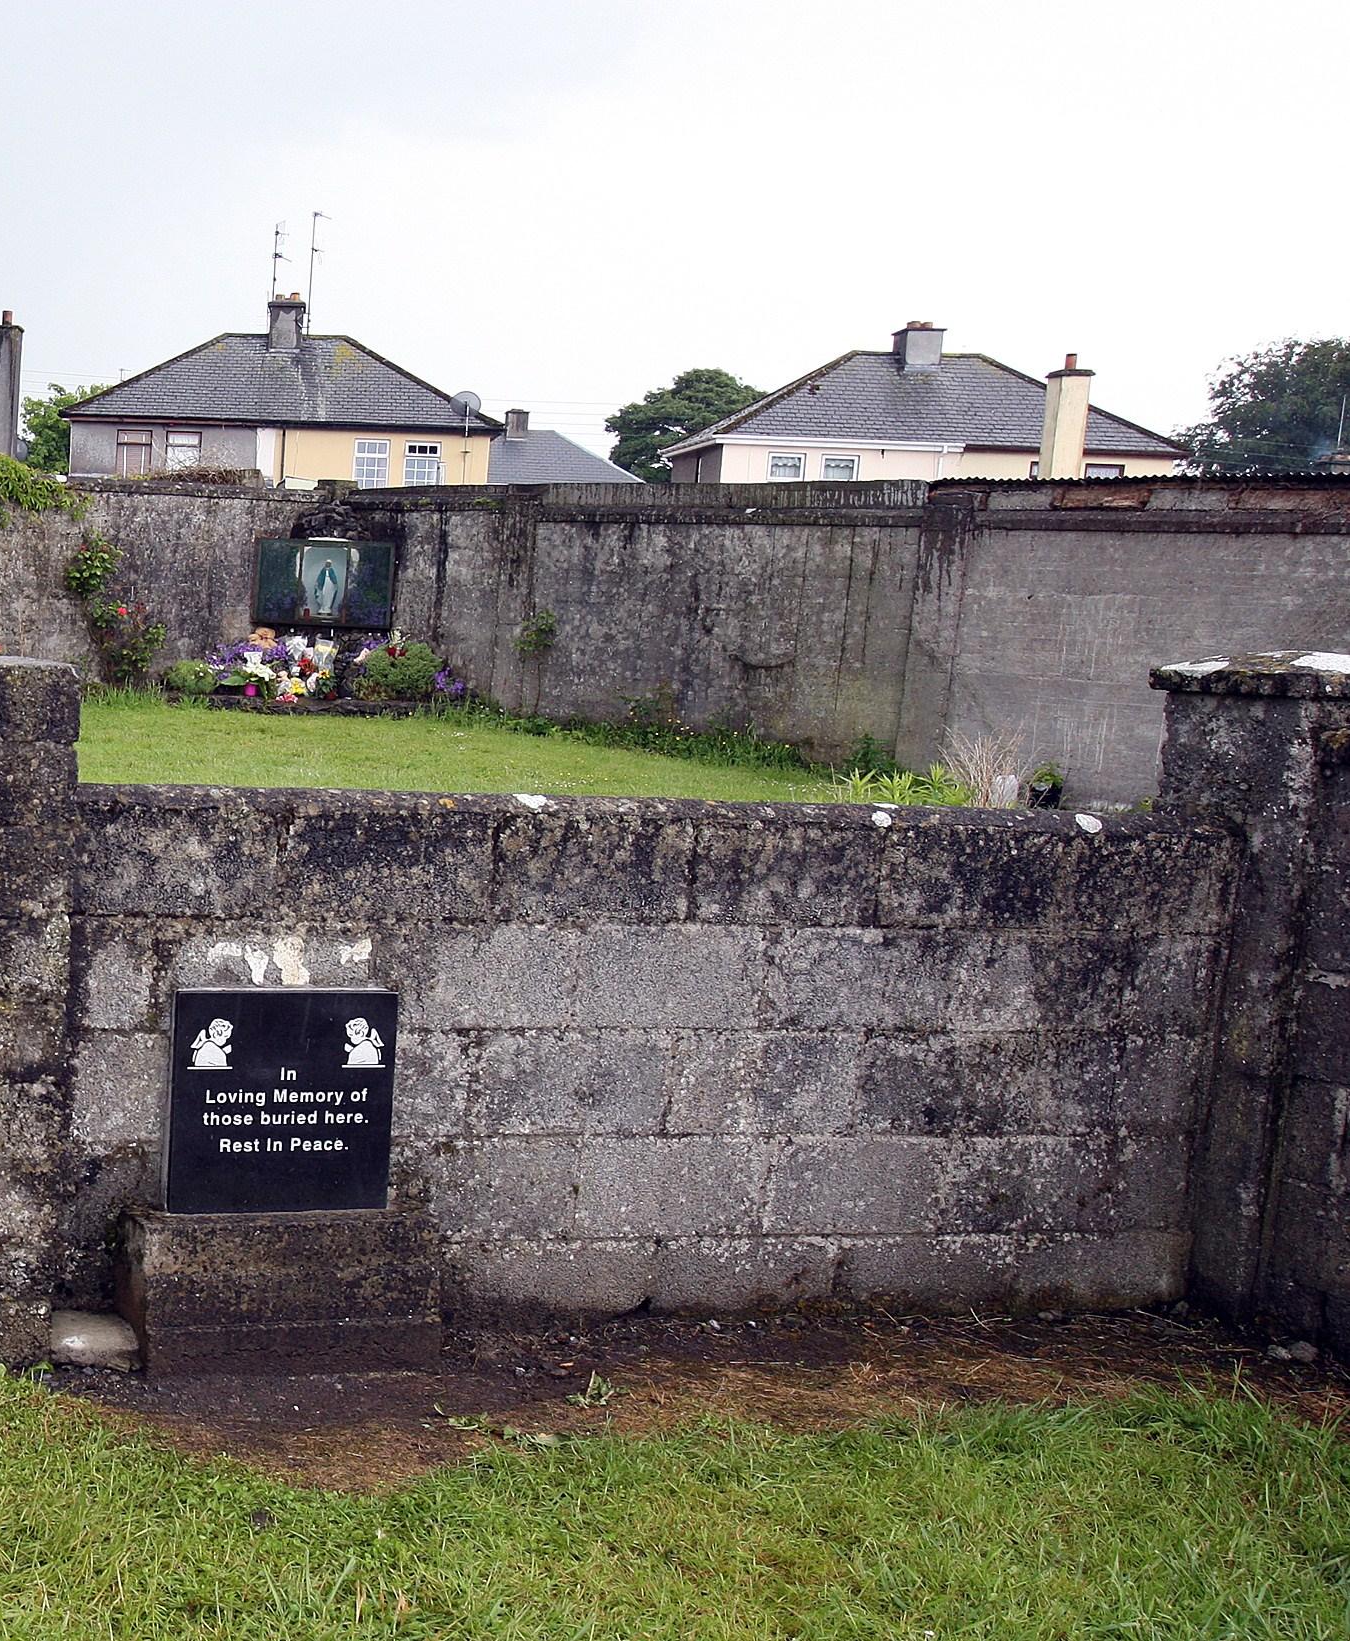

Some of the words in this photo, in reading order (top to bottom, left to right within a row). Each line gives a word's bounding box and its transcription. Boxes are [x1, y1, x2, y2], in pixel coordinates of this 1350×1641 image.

[280, 1066, 297, 1081] In
[205, 1089, 266, 1107] Loving
[273, 1088, 344, 1106] Memory
[350, 1087, 368, 1102] of
[202, 1112, 254, 1126] those
[260, 1110, 318, 1125] buried
[324, 1110, 369, 1124] here.
[219, 1138, 260, 1153] Rest
[266, 1137, 283, 1152] In
[290, 1137, 349, 1152] Peace.
